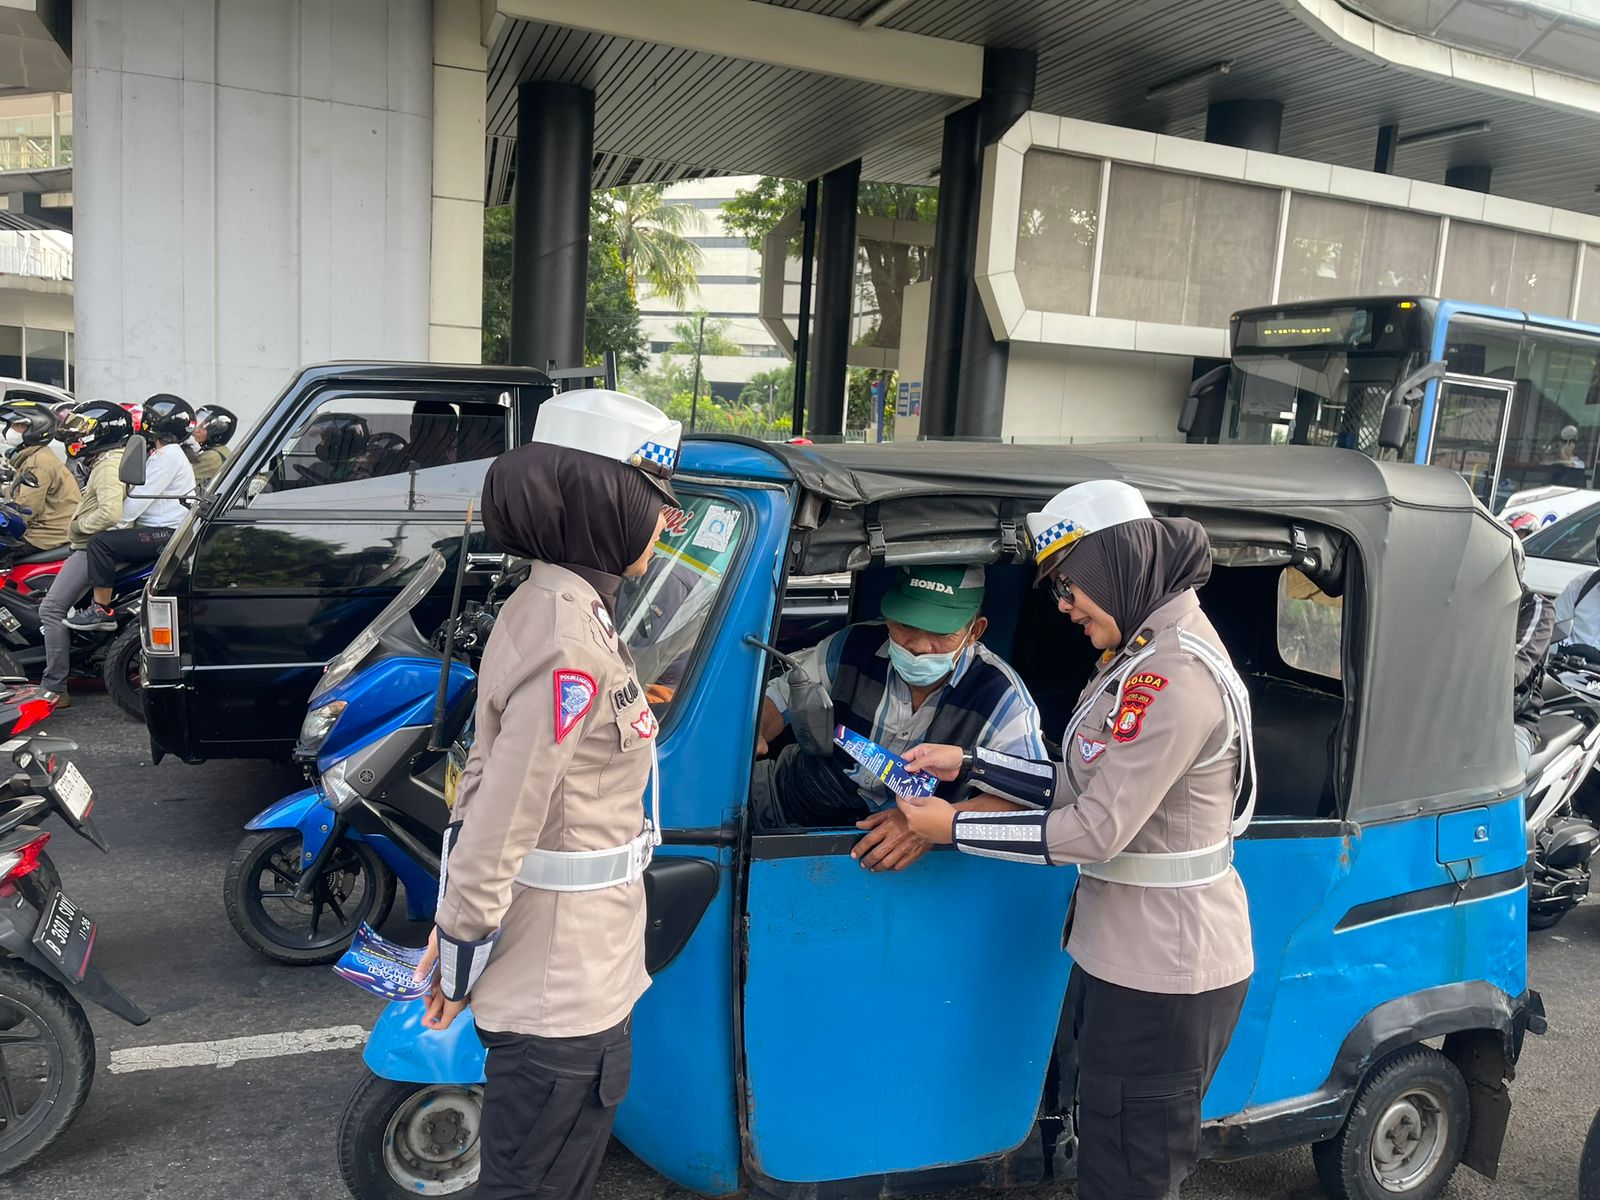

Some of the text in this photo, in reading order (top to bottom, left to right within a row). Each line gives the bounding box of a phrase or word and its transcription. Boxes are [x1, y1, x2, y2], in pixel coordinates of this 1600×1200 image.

[910, 578, 954, 594] HONDA
[45, 896, 76, 956] B 3601 SUY
